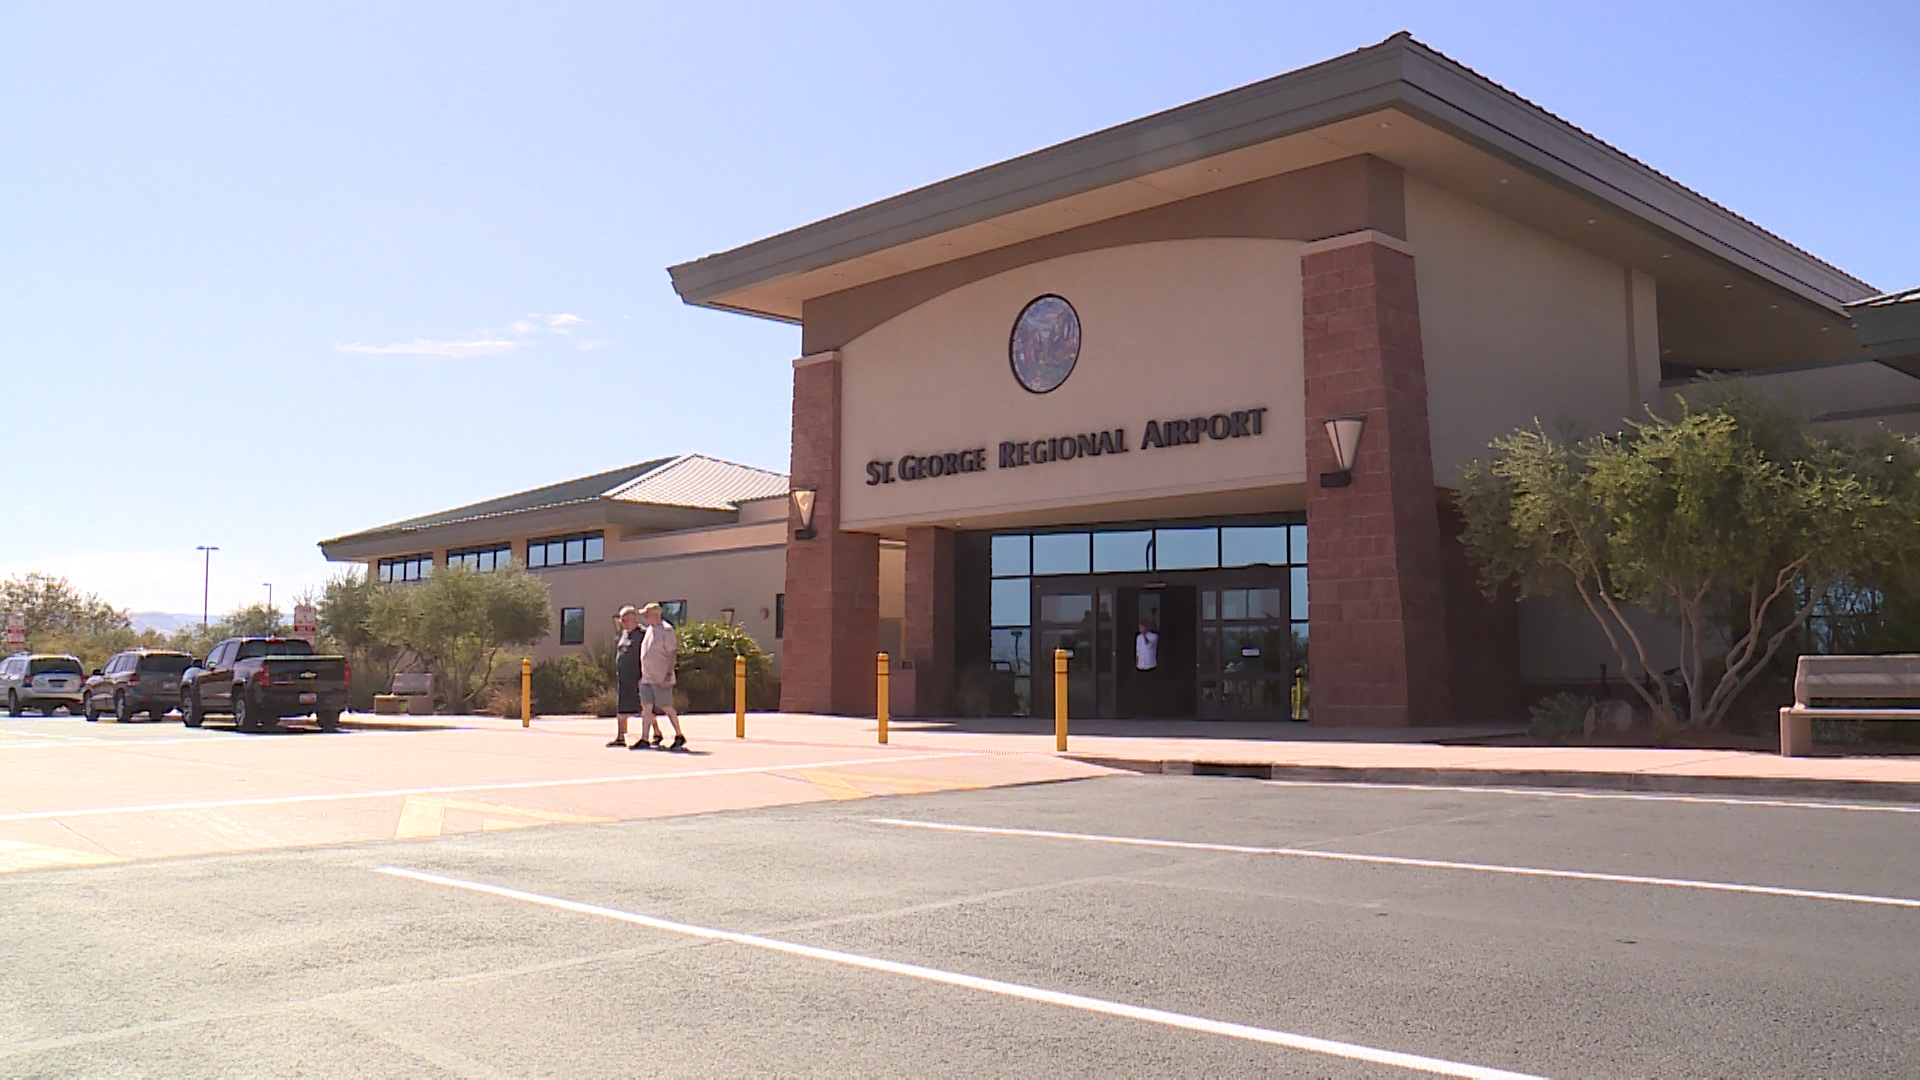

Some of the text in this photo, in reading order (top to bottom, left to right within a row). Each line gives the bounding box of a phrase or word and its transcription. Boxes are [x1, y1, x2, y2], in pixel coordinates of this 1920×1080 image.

[866, 407, 1268, 486] ST. GEORGE REGIONAL AIRPORT
